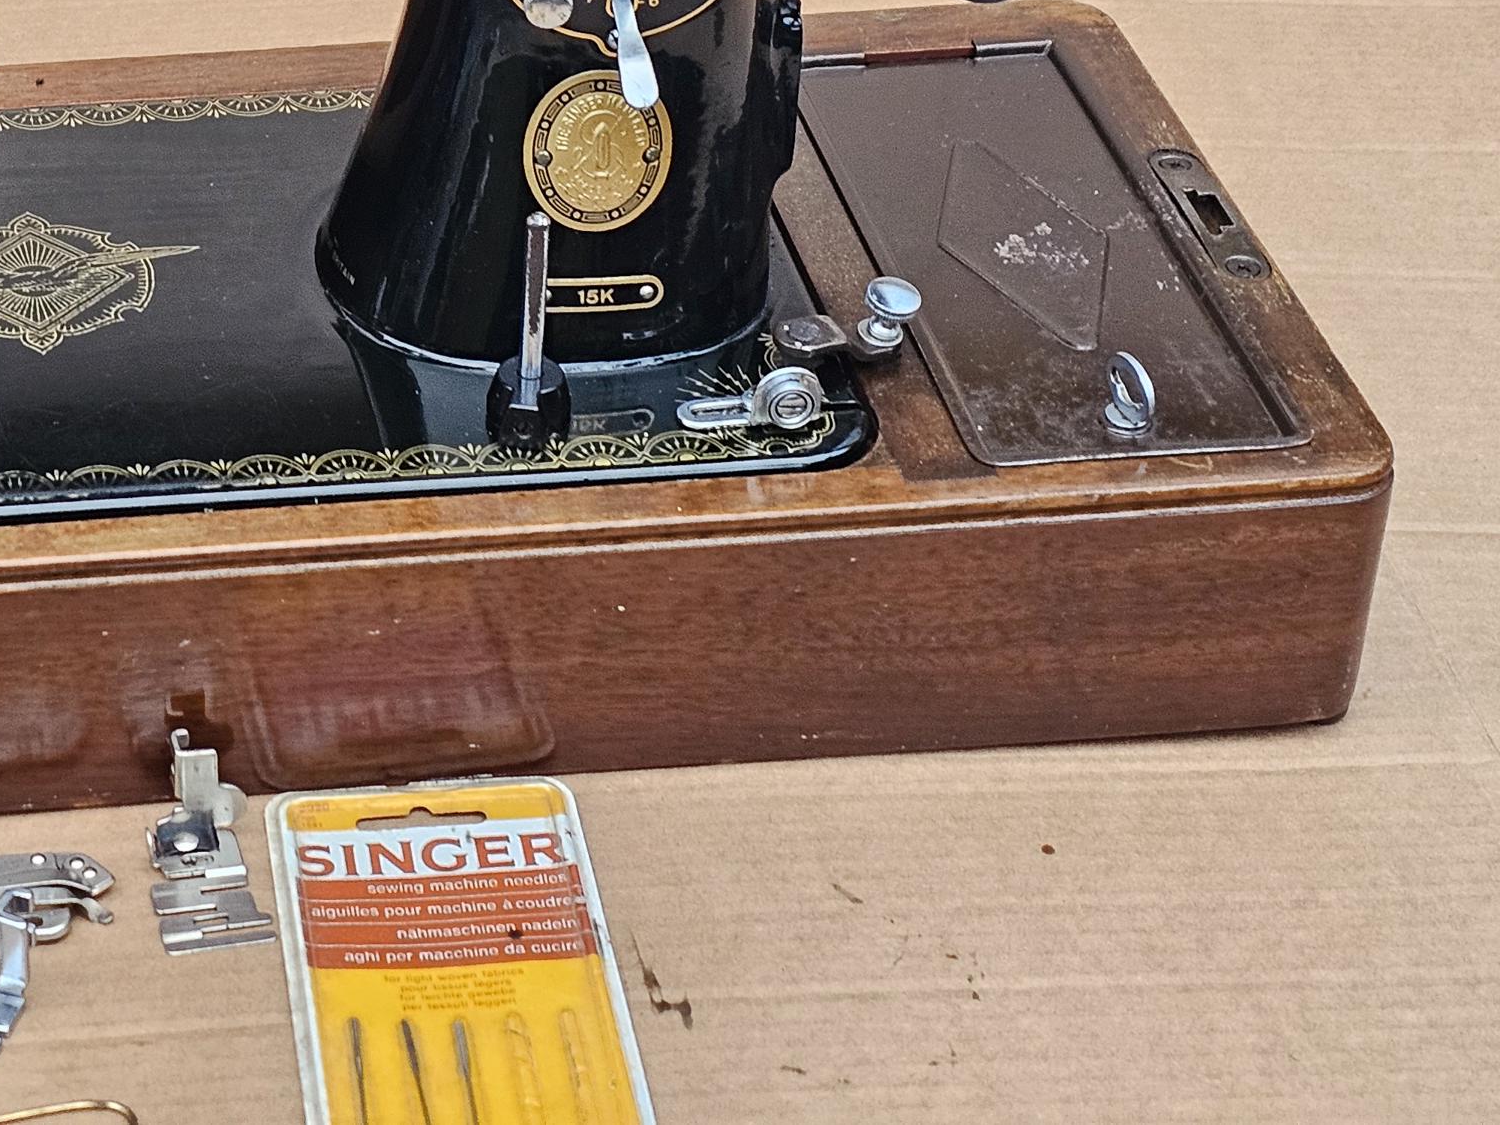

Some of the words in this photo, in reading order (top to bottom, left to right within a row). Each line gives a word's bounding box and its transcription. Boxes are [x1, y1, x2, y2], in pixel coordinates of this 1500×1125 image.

[577, 289, 615, 304] 15K
[299, 833, 569, 876] SINGER
[367, 881, 424, 895] sewing
[430, 878, 498, 892] machine
[504, 873, 567, 887] needles
[311, 905, 379, 920] aiguilles
[384, 906, 421, 919] pour
[428, 900, 496, 915] machine
[515, 896, 573, 909] coudre
[521, 918, 576, 931] nadeln
[344, 951, 380, 964] aghi
[386, 951, 413, 964] per
[419, 944, 498, 962] macchine
[505, 943, 526, 955] da
